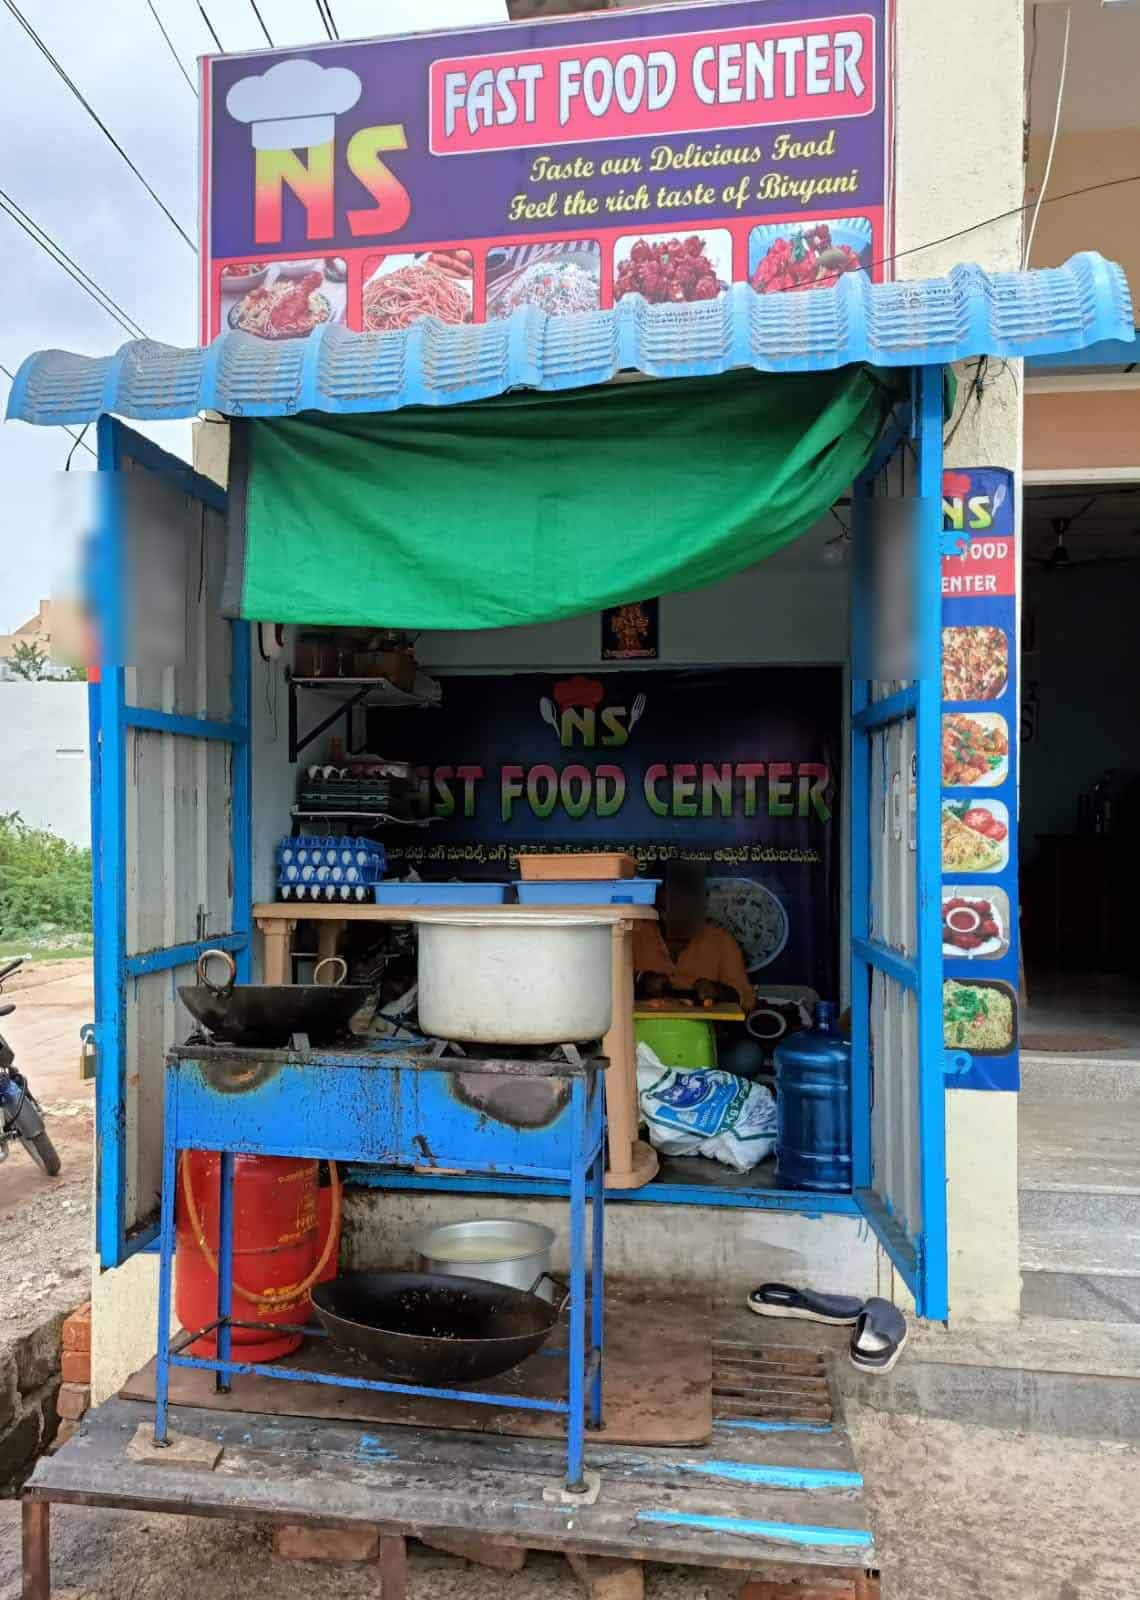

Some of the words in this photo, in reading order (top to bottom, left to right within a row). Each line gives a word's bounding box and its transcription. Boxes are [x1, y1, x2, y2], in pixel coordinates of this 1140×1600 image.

[444, 62, 544, 138] FAST
[558, 49, 677, 127] FOOD
[691, 31, 865, 106] CENTER
[529, 154, 594, 183] Taste
[600, 155, 643, 176] our
[648, 143, 761, 172] Delicious
[773, 131, 835, 159] Food
[255, 124, 411, 243] NS
[508, 193, 556, 221] Feel
[561, 190, 600, 216] the
[605, 185, 650, 212] rich
[655, 181, 716, 206] taste
[720, 179, 752, 208] of
[756, 169, 858, 205] Biryani
[962, 541, 1008, 562] OOD
[941, 574, 997, 593] ENTER
[560, 707, 628, 747] NS
[500, 763, 627, 824] FOOD
[643, 762, 832, 822] CENTER
